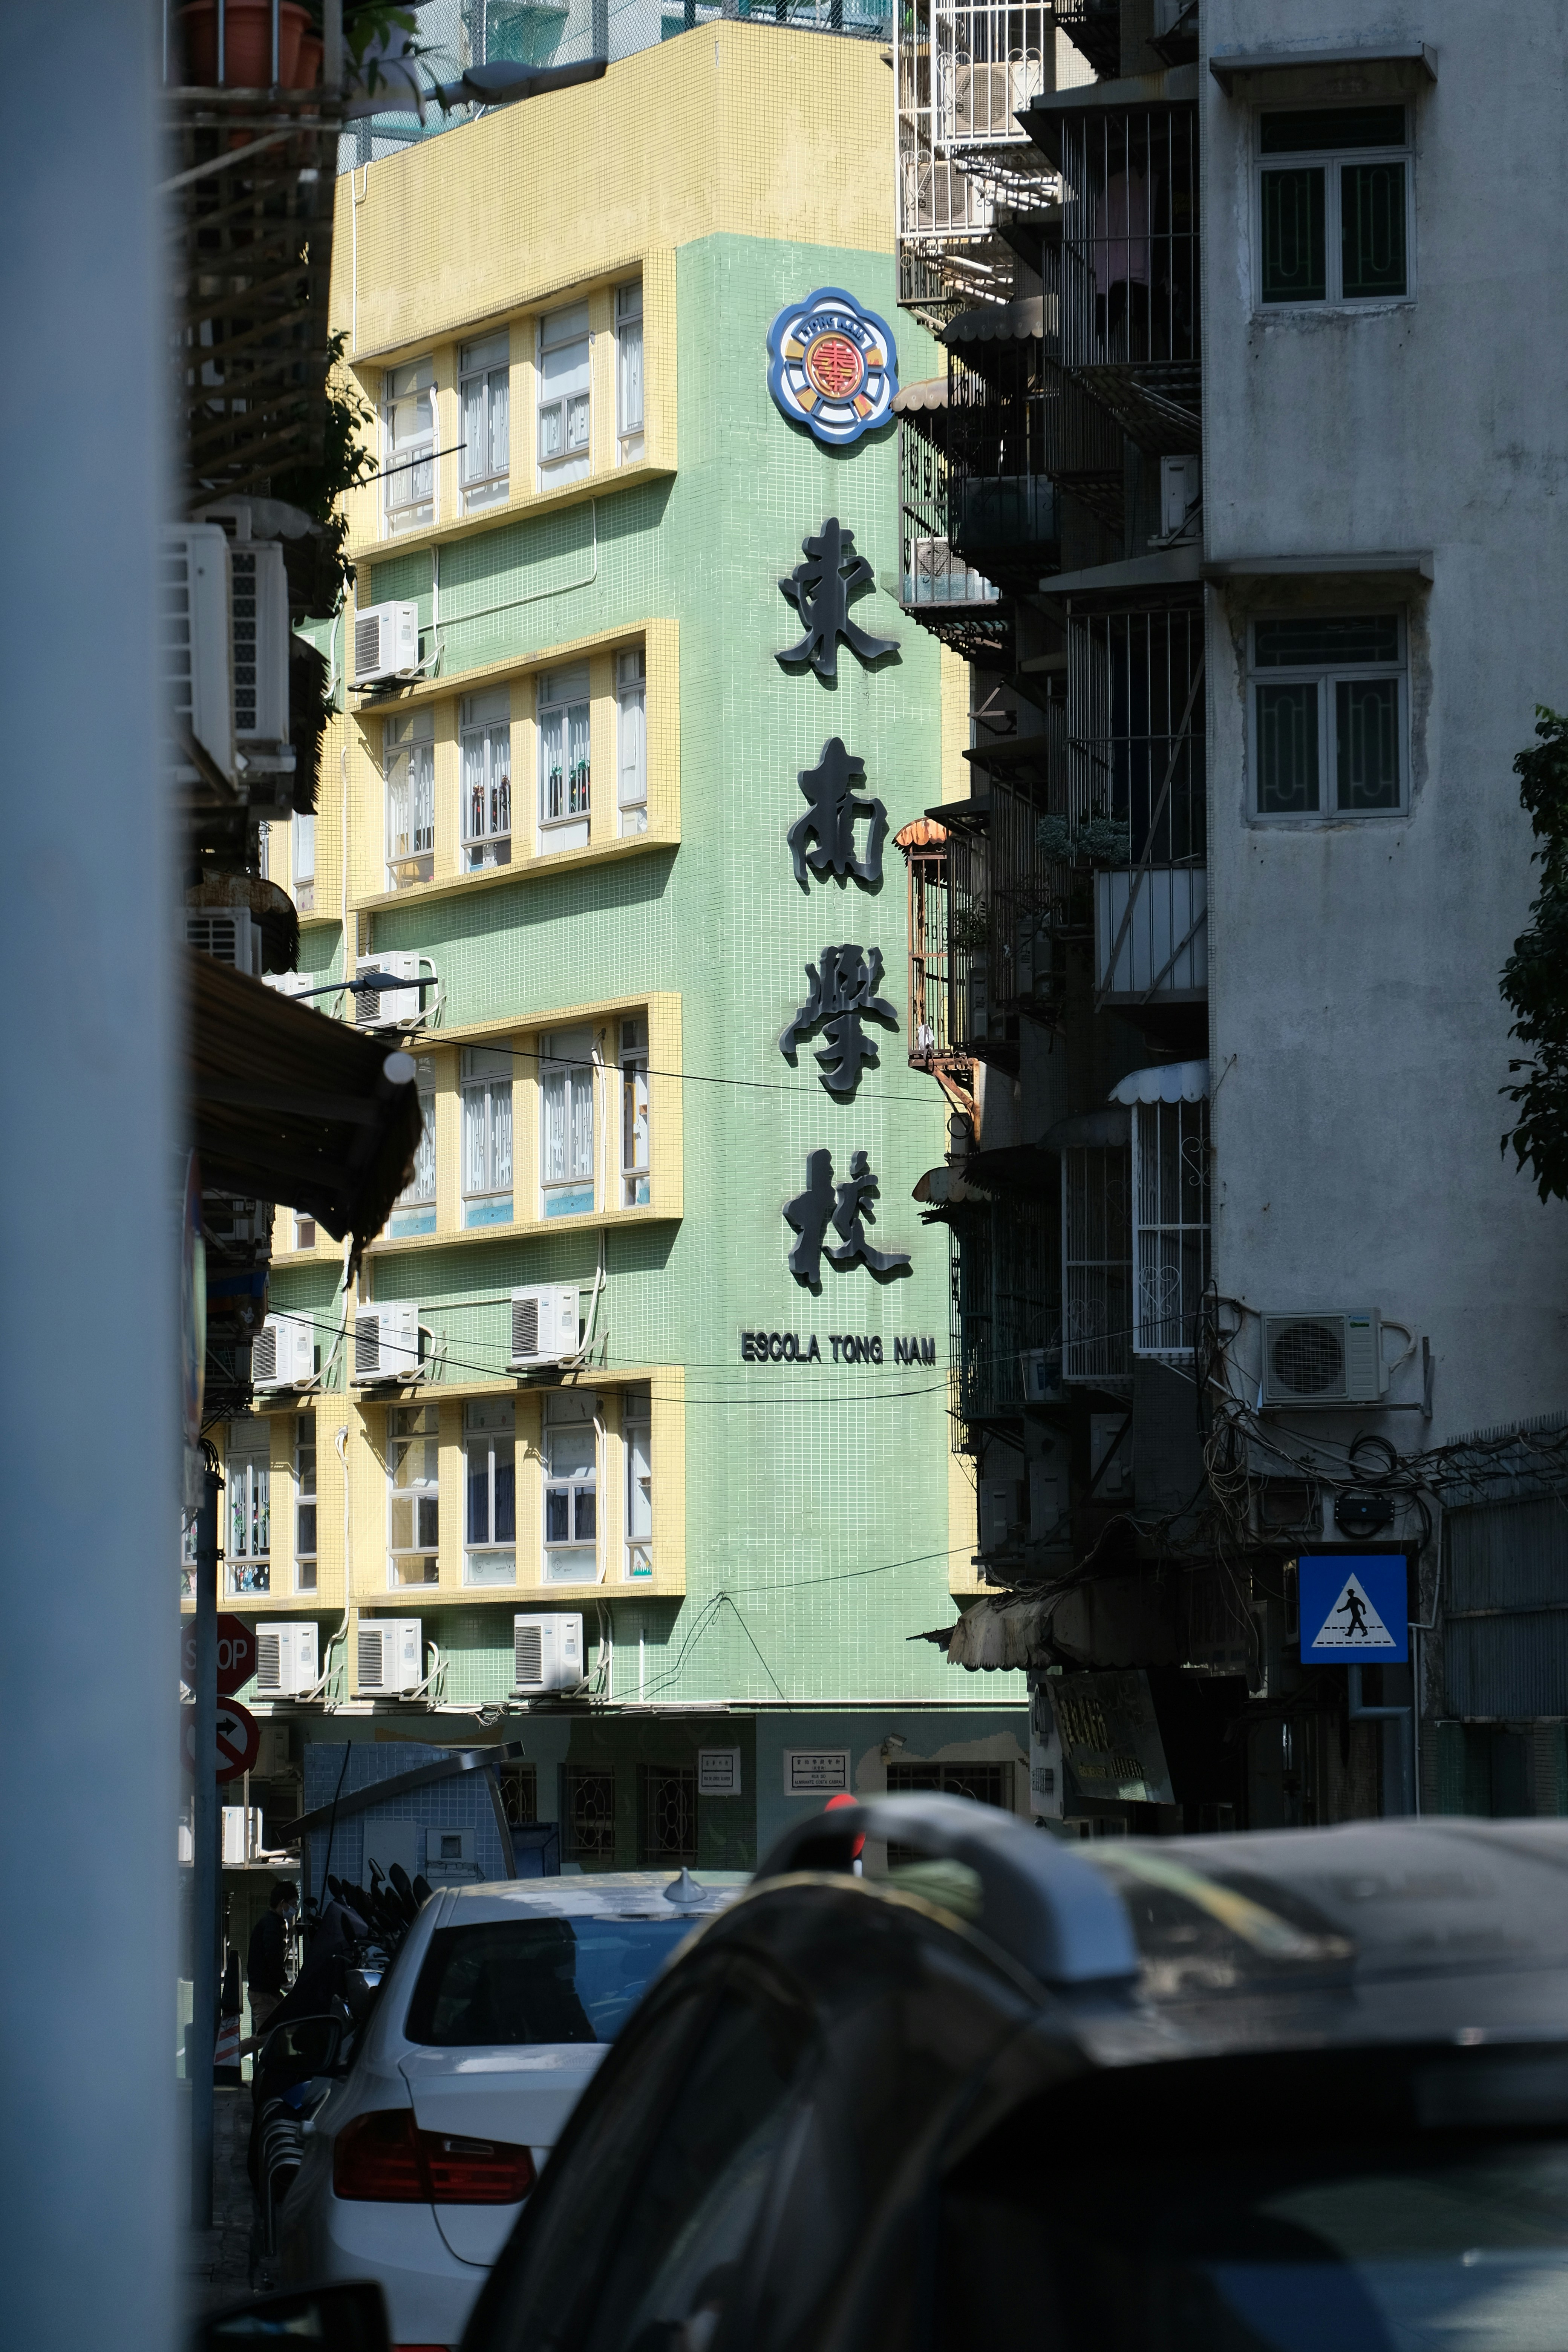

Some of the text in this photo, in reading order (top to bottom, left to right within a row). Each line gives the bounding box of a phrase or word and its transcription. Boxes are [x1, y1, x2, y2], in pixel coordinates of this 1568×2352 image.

[801, 315, 865, 340] TONG NAM
[774, 517, 911, 1283] 東南學校
[741, 1332, 936, 1361] ESCOLA TONG NAM
[185, 1639, 248, 1670] SOP
